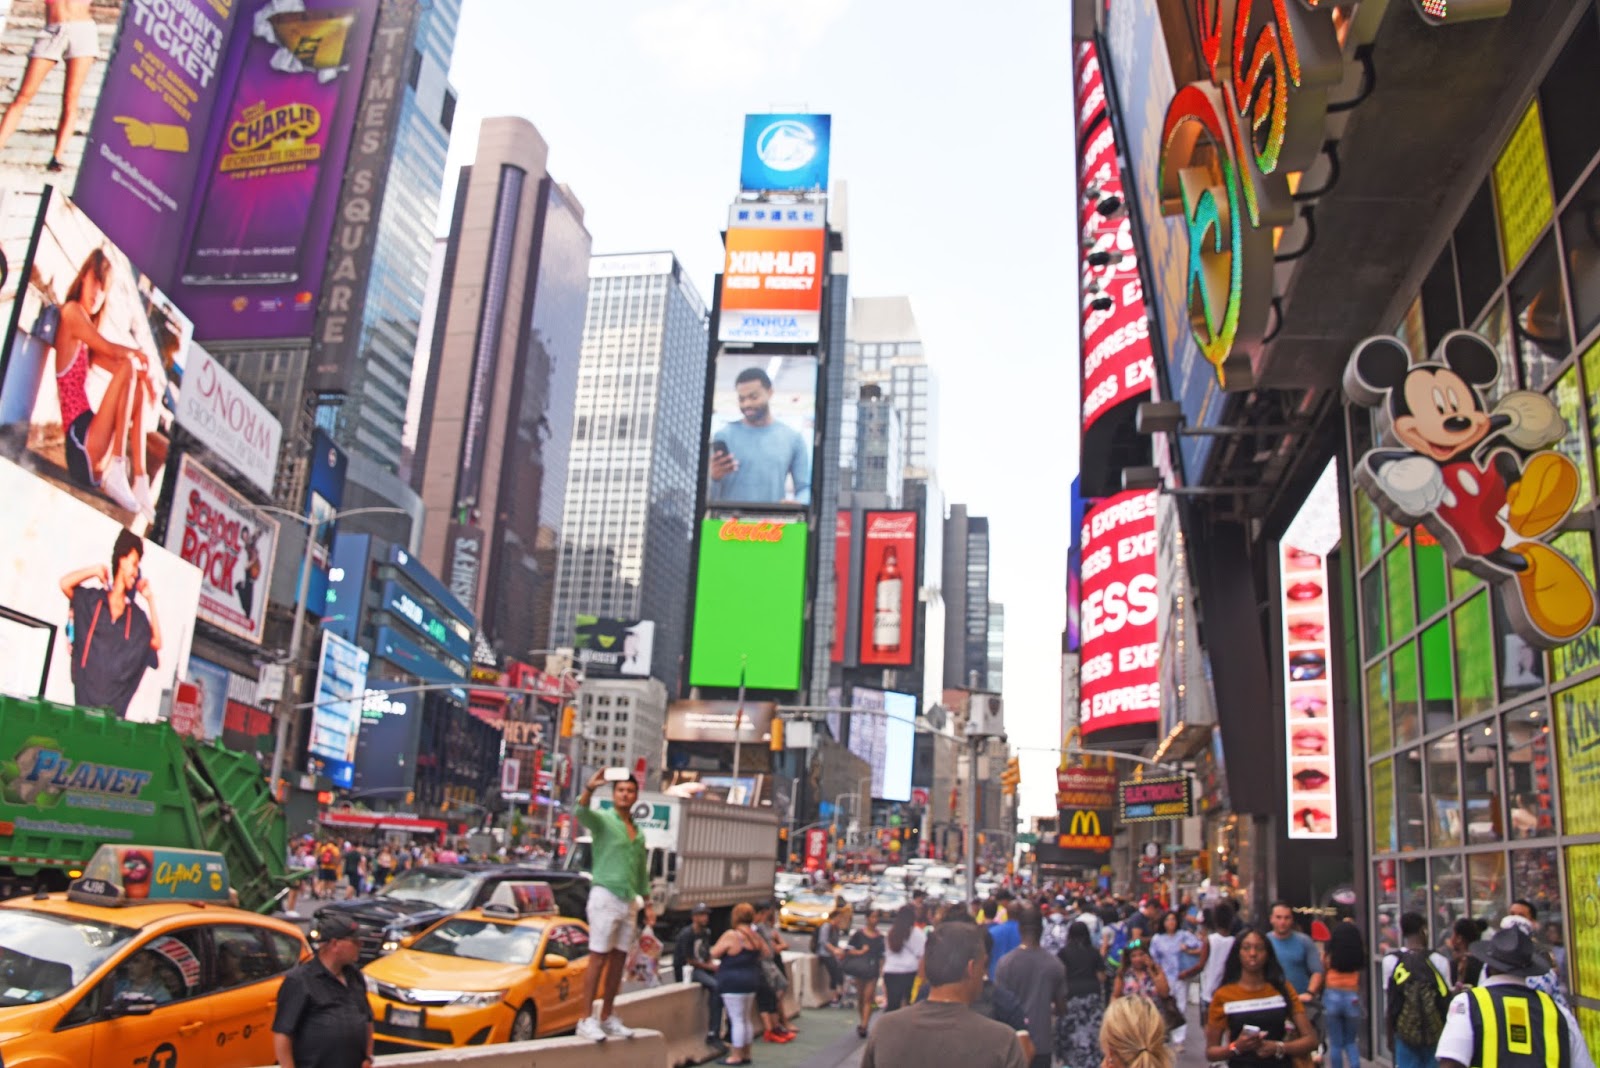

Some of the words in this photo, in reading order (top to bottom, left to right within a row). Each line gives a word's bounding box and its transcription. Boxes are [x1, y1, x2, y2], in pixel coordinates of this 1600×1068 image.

[133, 0, 214, 88] TICKET
[142, 0, 218, 70] OLDEN
[360, 27, 404, 154] TIMES
[231, 106, 316, 149] CHARLIE
[322, 169, 372, 343] SQUARE
[726, 276, 760, 289] NEWS
[764, 276, 814, 290] AGENCY
[728, 251, 816, 275] XINHUA
[742, 317, 797, 327] XINHUA
[1085, 315, 1150, 380] EXPRESS
[196, 359, 272, 460] WRONG
[187, 488, 241, 557] SCHOOL
[181, 525, 237, 596] ROCK
[26, 749, 152, 796] PLANET
